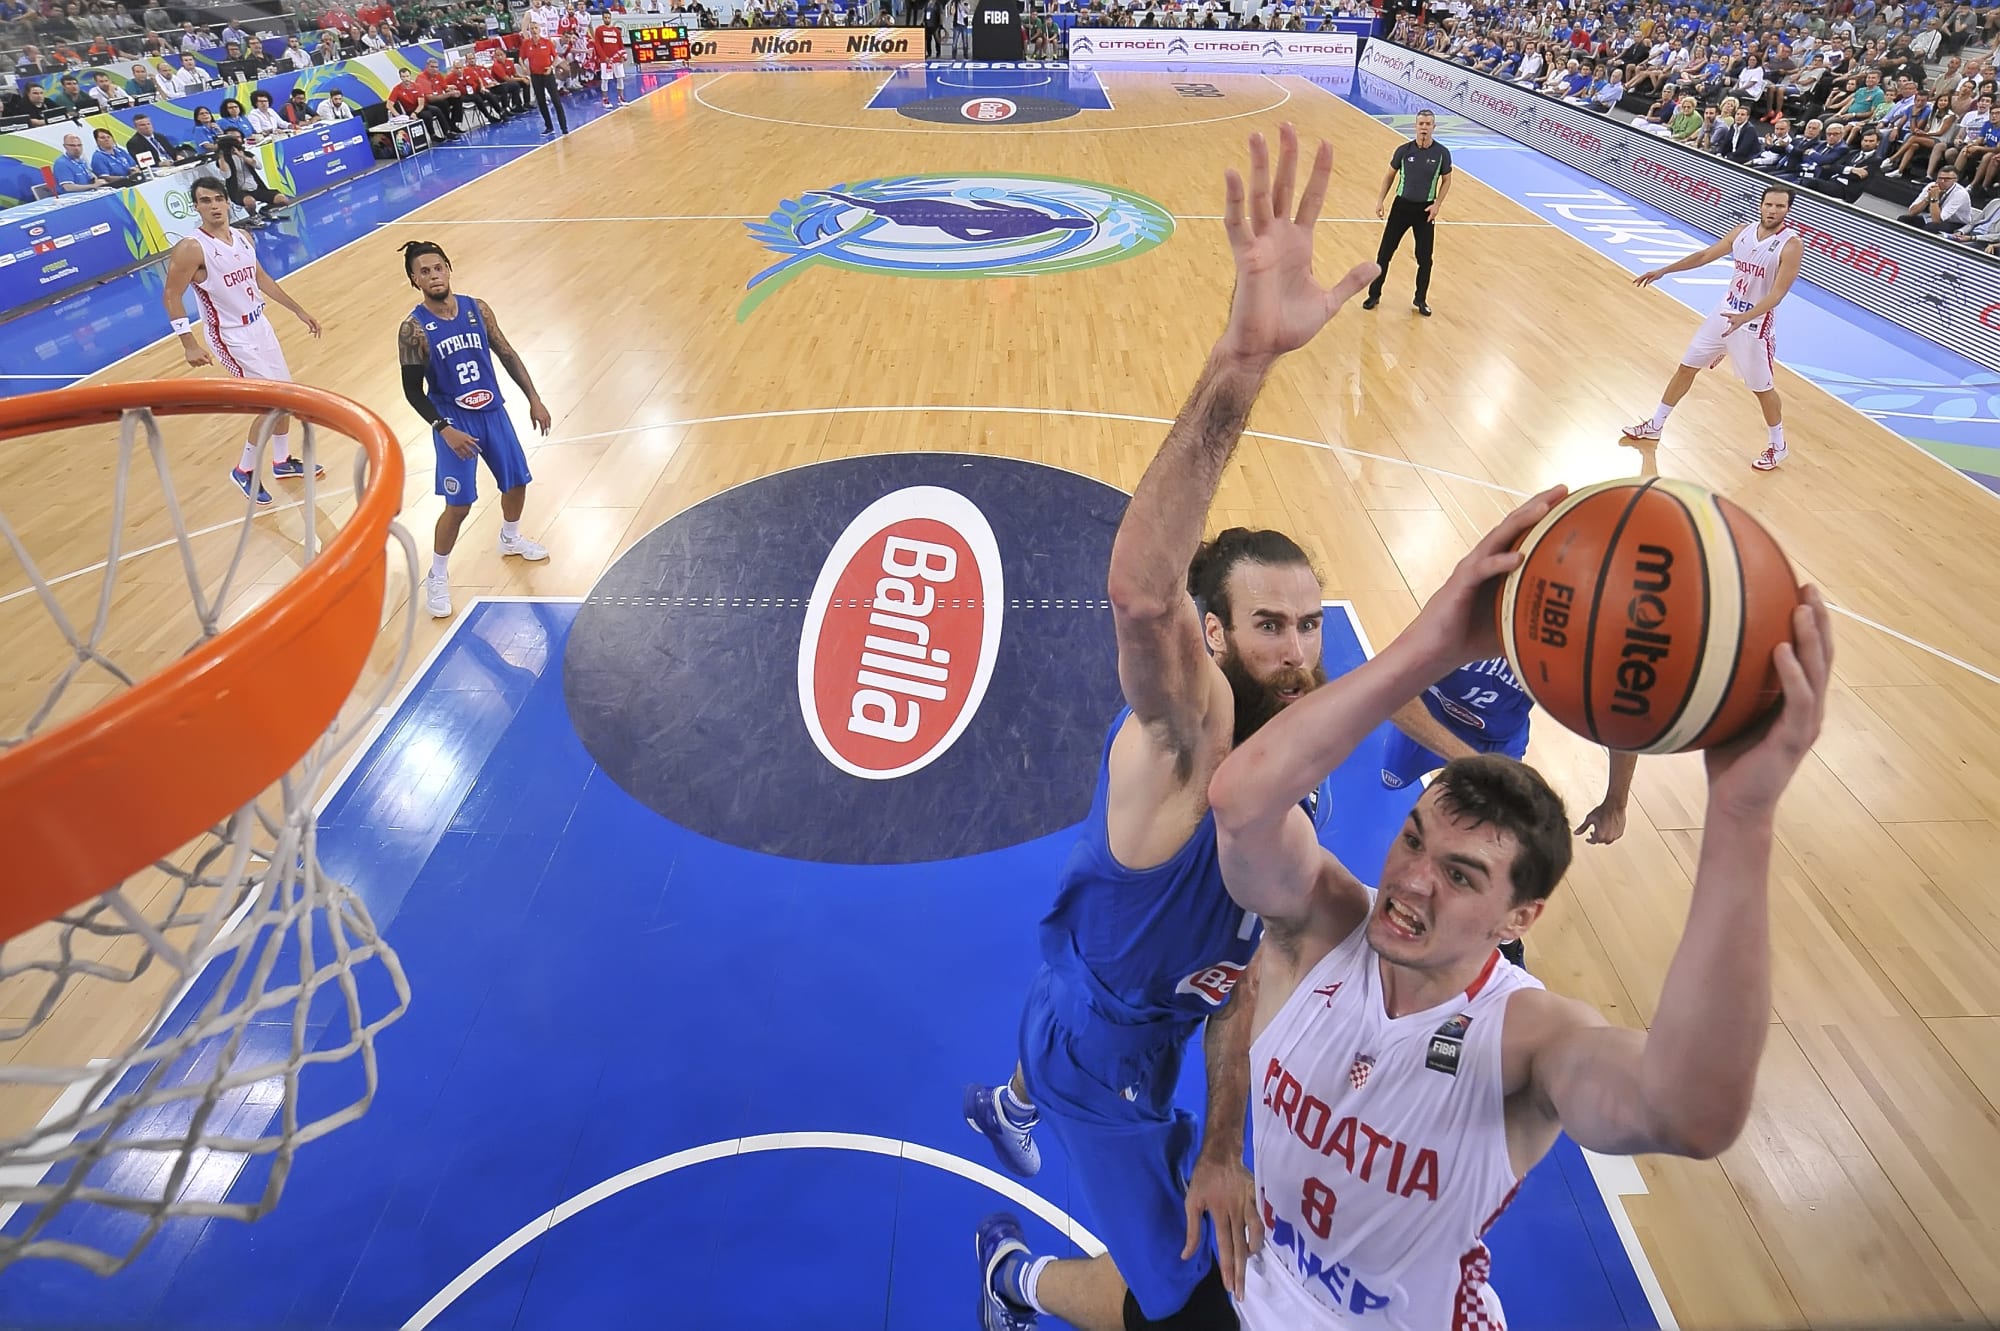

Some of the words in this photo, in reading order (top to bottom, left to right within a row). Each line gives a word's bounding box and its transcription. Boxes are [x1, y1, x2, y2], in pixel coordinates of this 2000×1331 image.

[984, 11, 1009, 24] FIBA
[751, 36, 812, 54] Nikon
[846, 35, 908, 53] Nikon
[1789, 220, 1899, 285] TROËN
[246, 287, 254, 302] 9
[436, 333, 483, 360] ITALIA
[456, 360, 481, 385] 23
[1541, 582, 1575, 648] FIBA
[847, 535, 958, 743] Barilla
[1611, 544, 1674, 717] molten
[1460, 686, 1499, 709] 12
[1433, 1041, 1456, 1057] FIBA
[1263, 1057, 1439, 1202] CROATIA
[1301, 1176, 1337, 1240] 8
